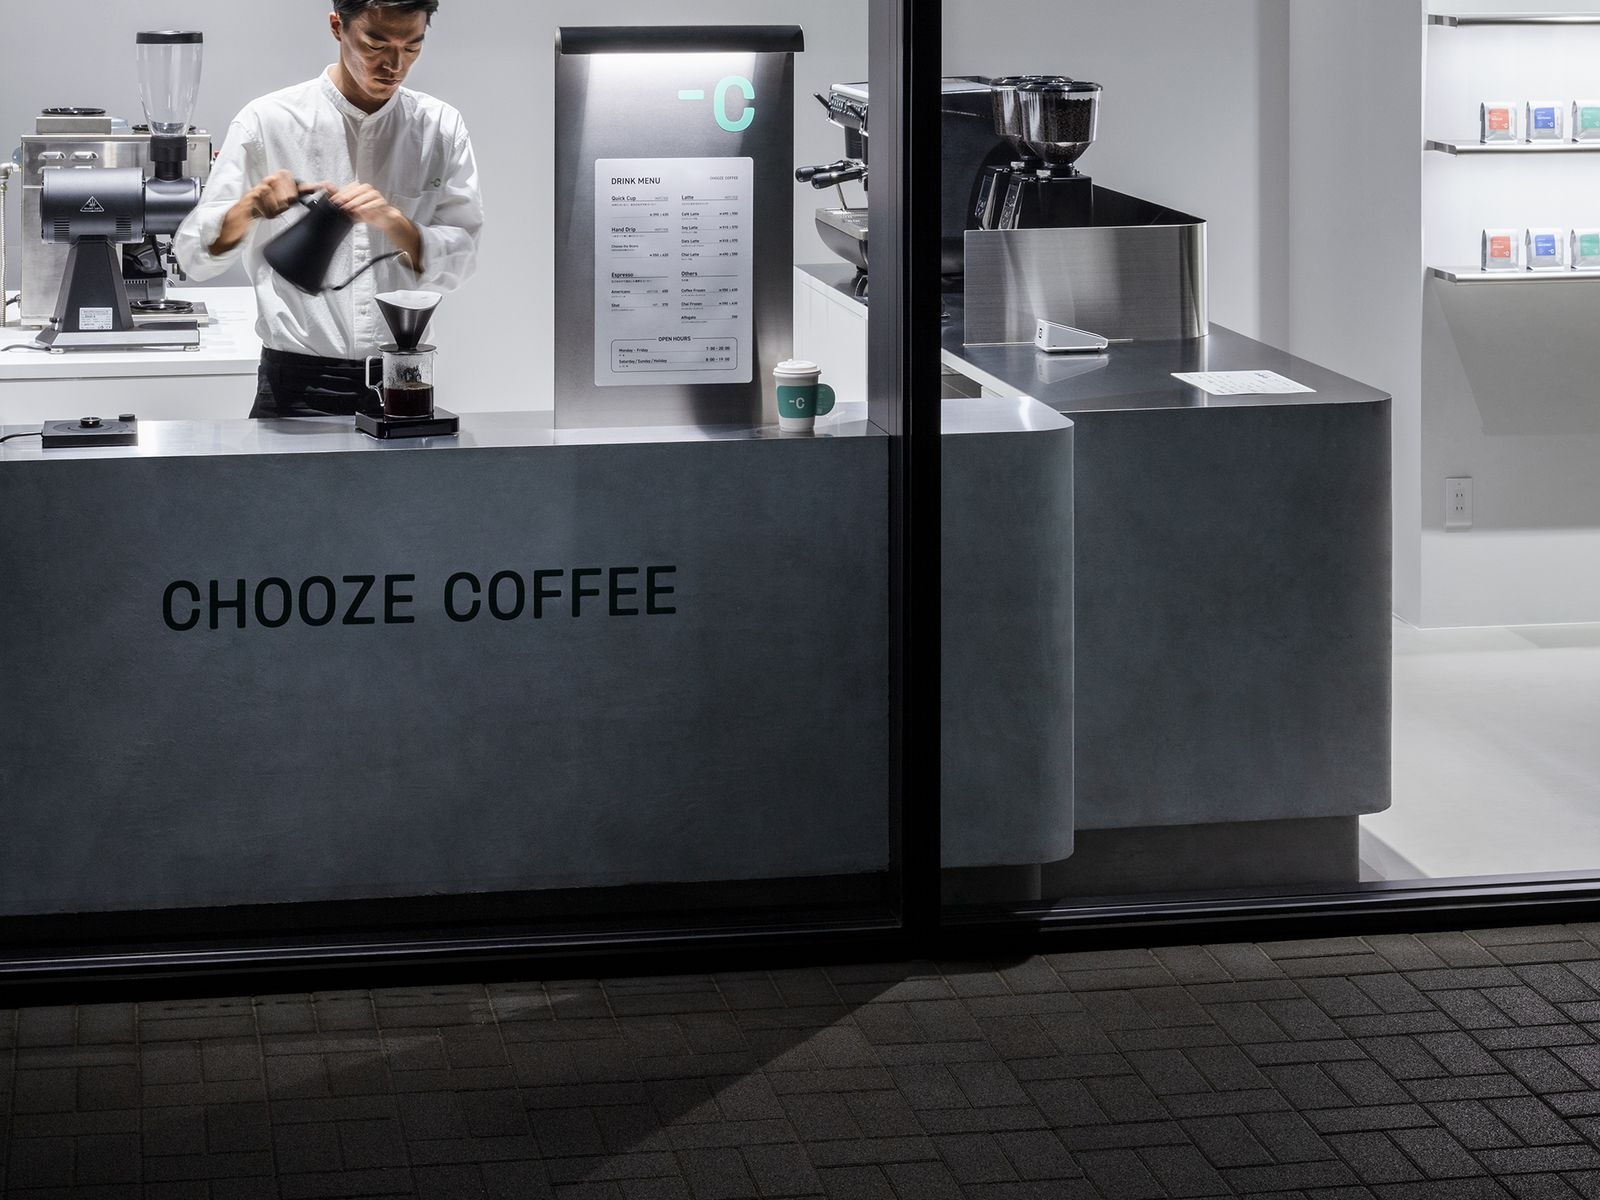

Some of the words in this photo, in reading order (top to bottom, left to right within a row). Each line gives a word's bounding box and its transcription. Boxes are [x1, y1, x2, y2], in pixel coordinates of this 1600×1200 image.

[611, 177, 636, 185] DRINK
[637, 176, 661, 185] MENU
[162, 573, 415, 631] CHOOZE
[444, 565, 677, 622] COFFEE
